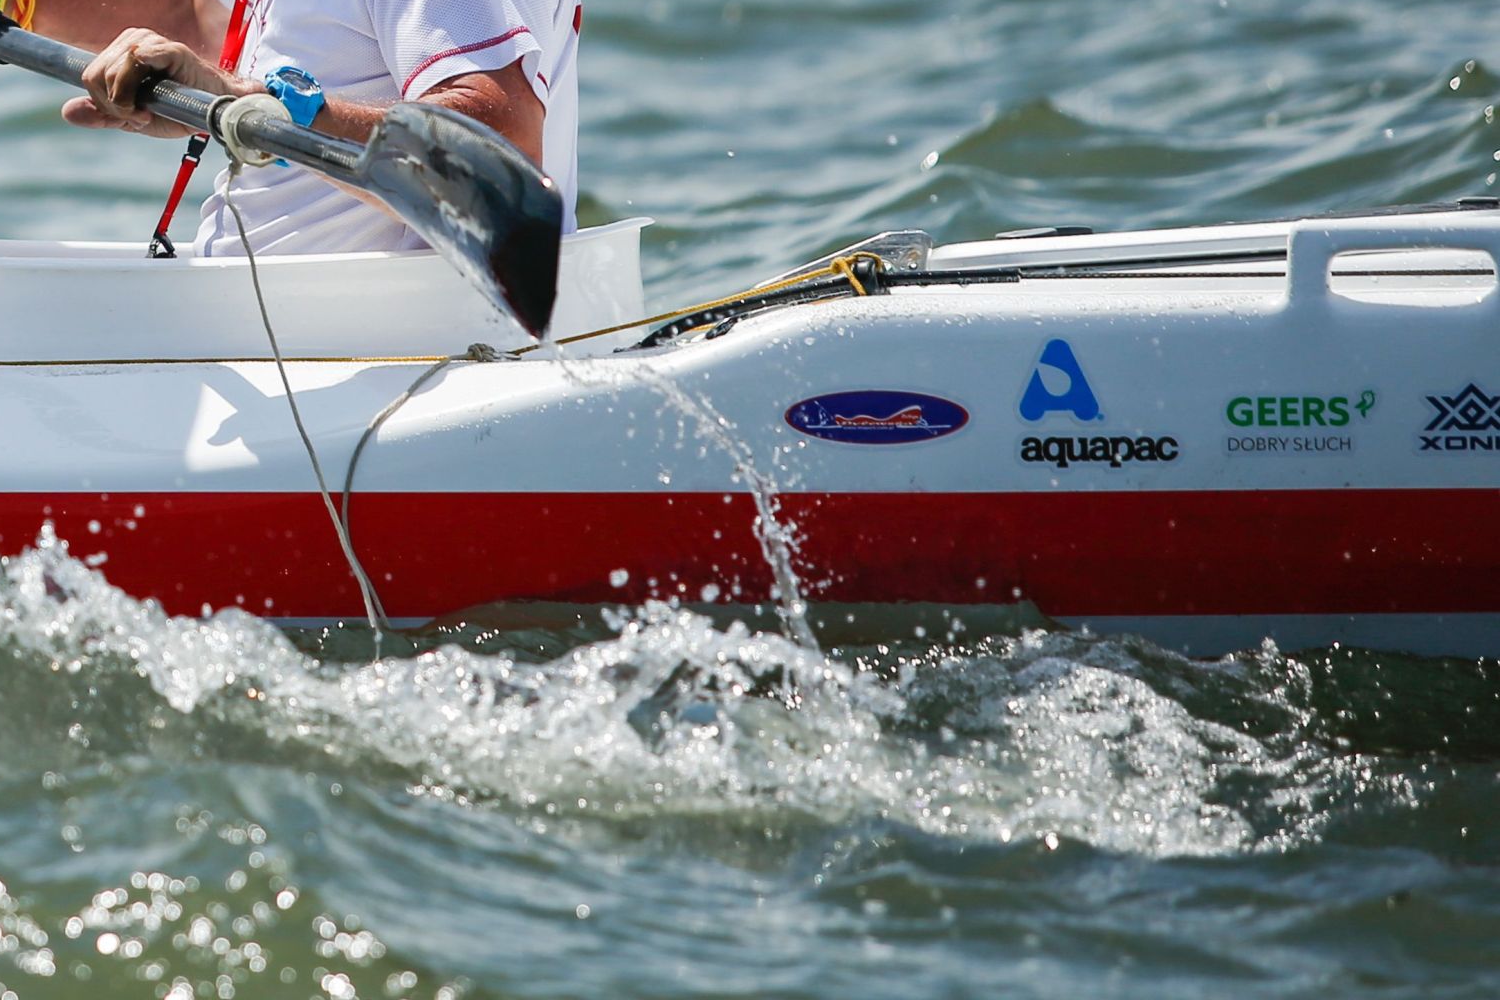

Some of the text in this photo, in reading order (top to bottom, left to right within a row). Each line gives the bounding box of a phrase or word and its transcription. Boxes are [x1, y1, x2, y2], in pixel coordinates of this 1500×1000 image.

[1226, 396, 1350, 427] GEERS
[1020, 436, 1179, 468] aquapac
[1227, 436, 1351, 451] DOBRY SŁUCH
